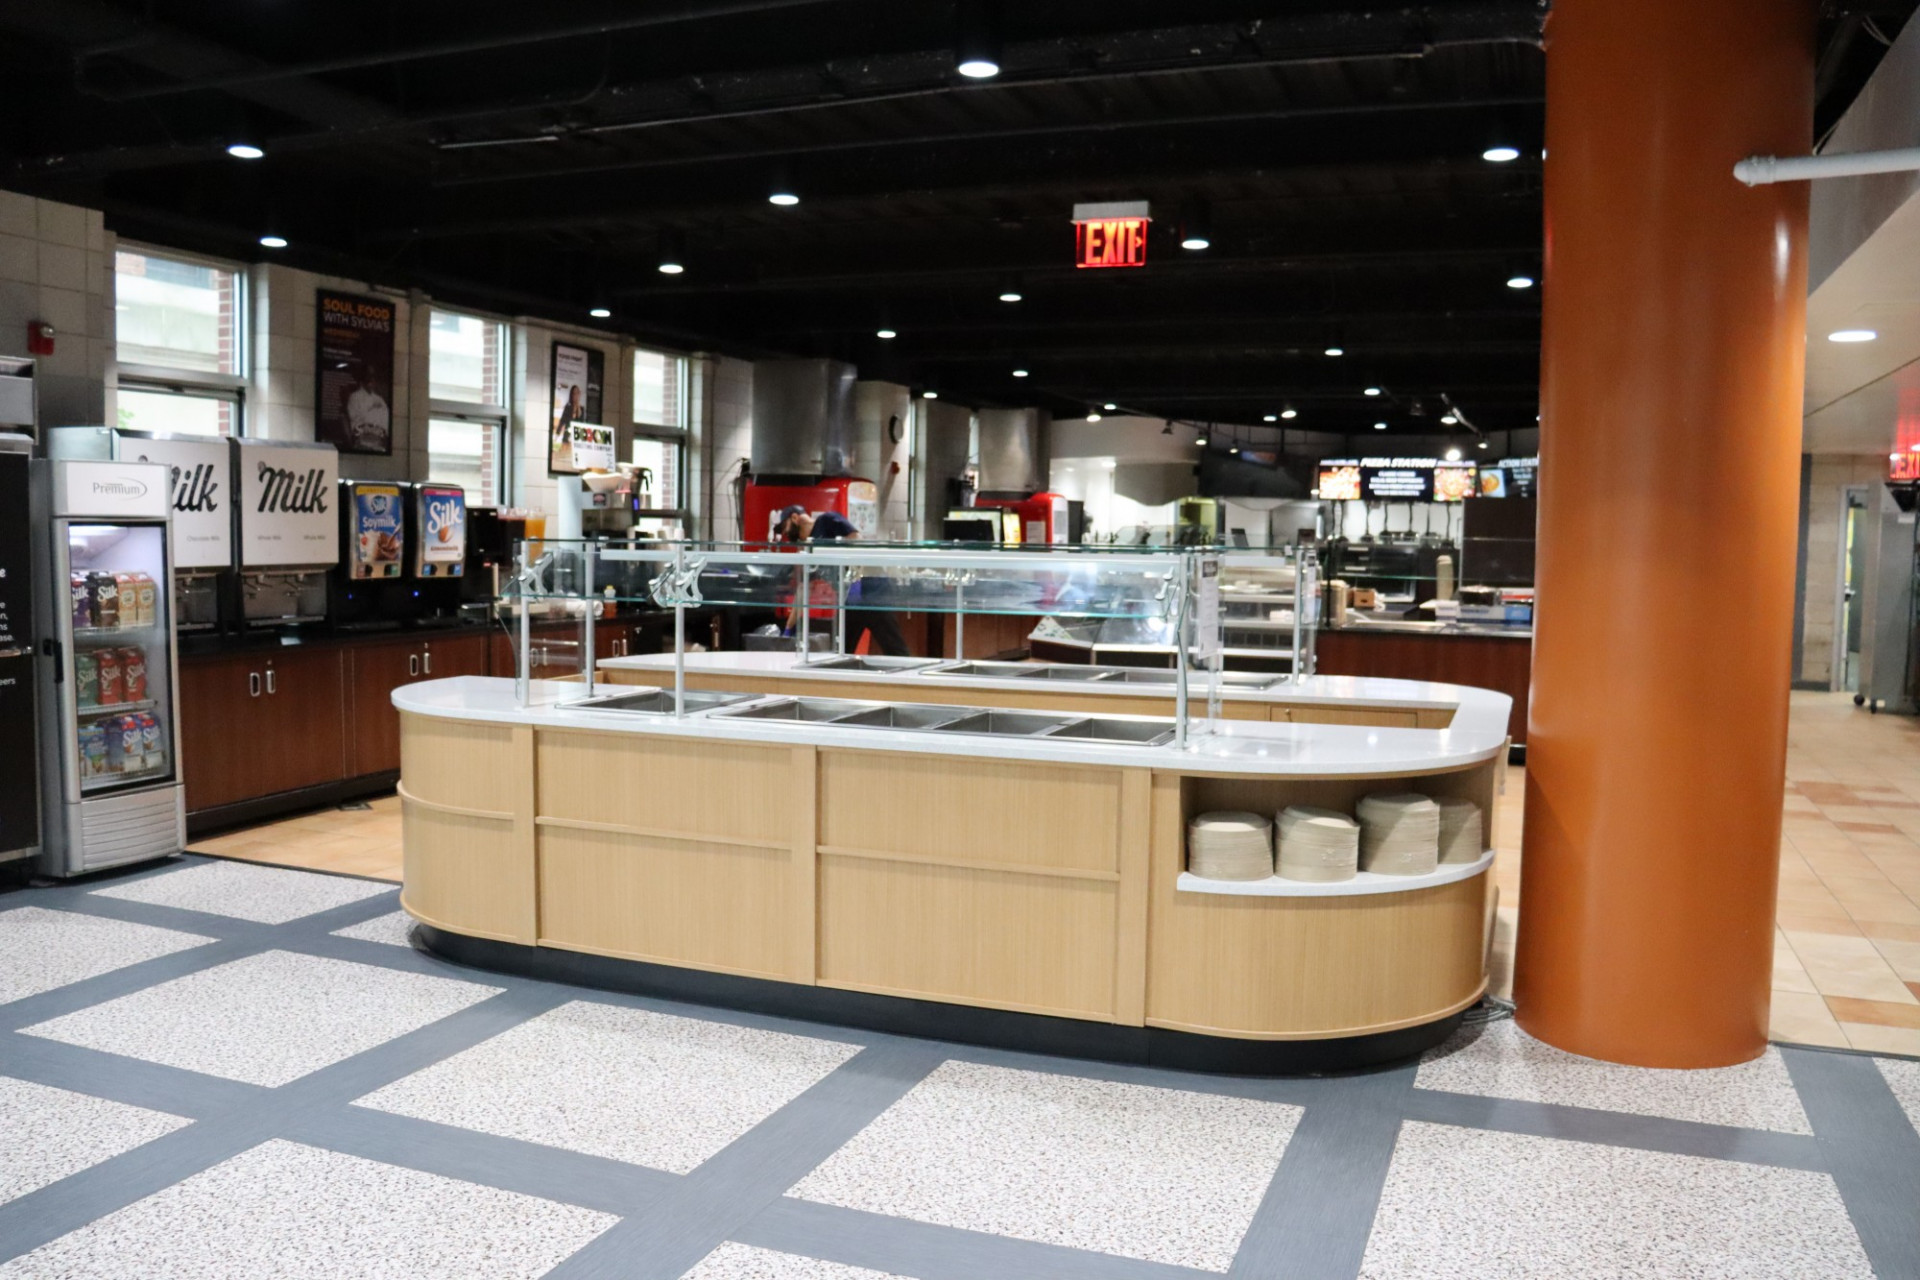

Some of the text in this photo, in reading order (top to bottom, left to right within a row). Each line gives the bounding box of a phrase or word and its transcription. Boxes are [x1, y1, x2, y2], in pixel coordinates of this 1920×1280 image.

[1085, 221, 1140, 264] EXIT
[323, 298, 390, 320] SOUL FOOD
[324, 311, 349, 325] WITH
[1360, 457, 1391, 468] PIZZA
[1391, 457, 1437, 469] STATION
[92, 482, 141, 495] Premium
[171, 464, 218, 512] ilk
[257, 461, 328, 513] Milk
[362, 515, 396, 529] Soymilk
[427, 499, 461, 534] Silk
[97, 585, 118, 602] Silk
[101, 665, 121, 682] Silk
[126, 663, 145, 680] Silk
[122, 729, 142, 747] Silk
